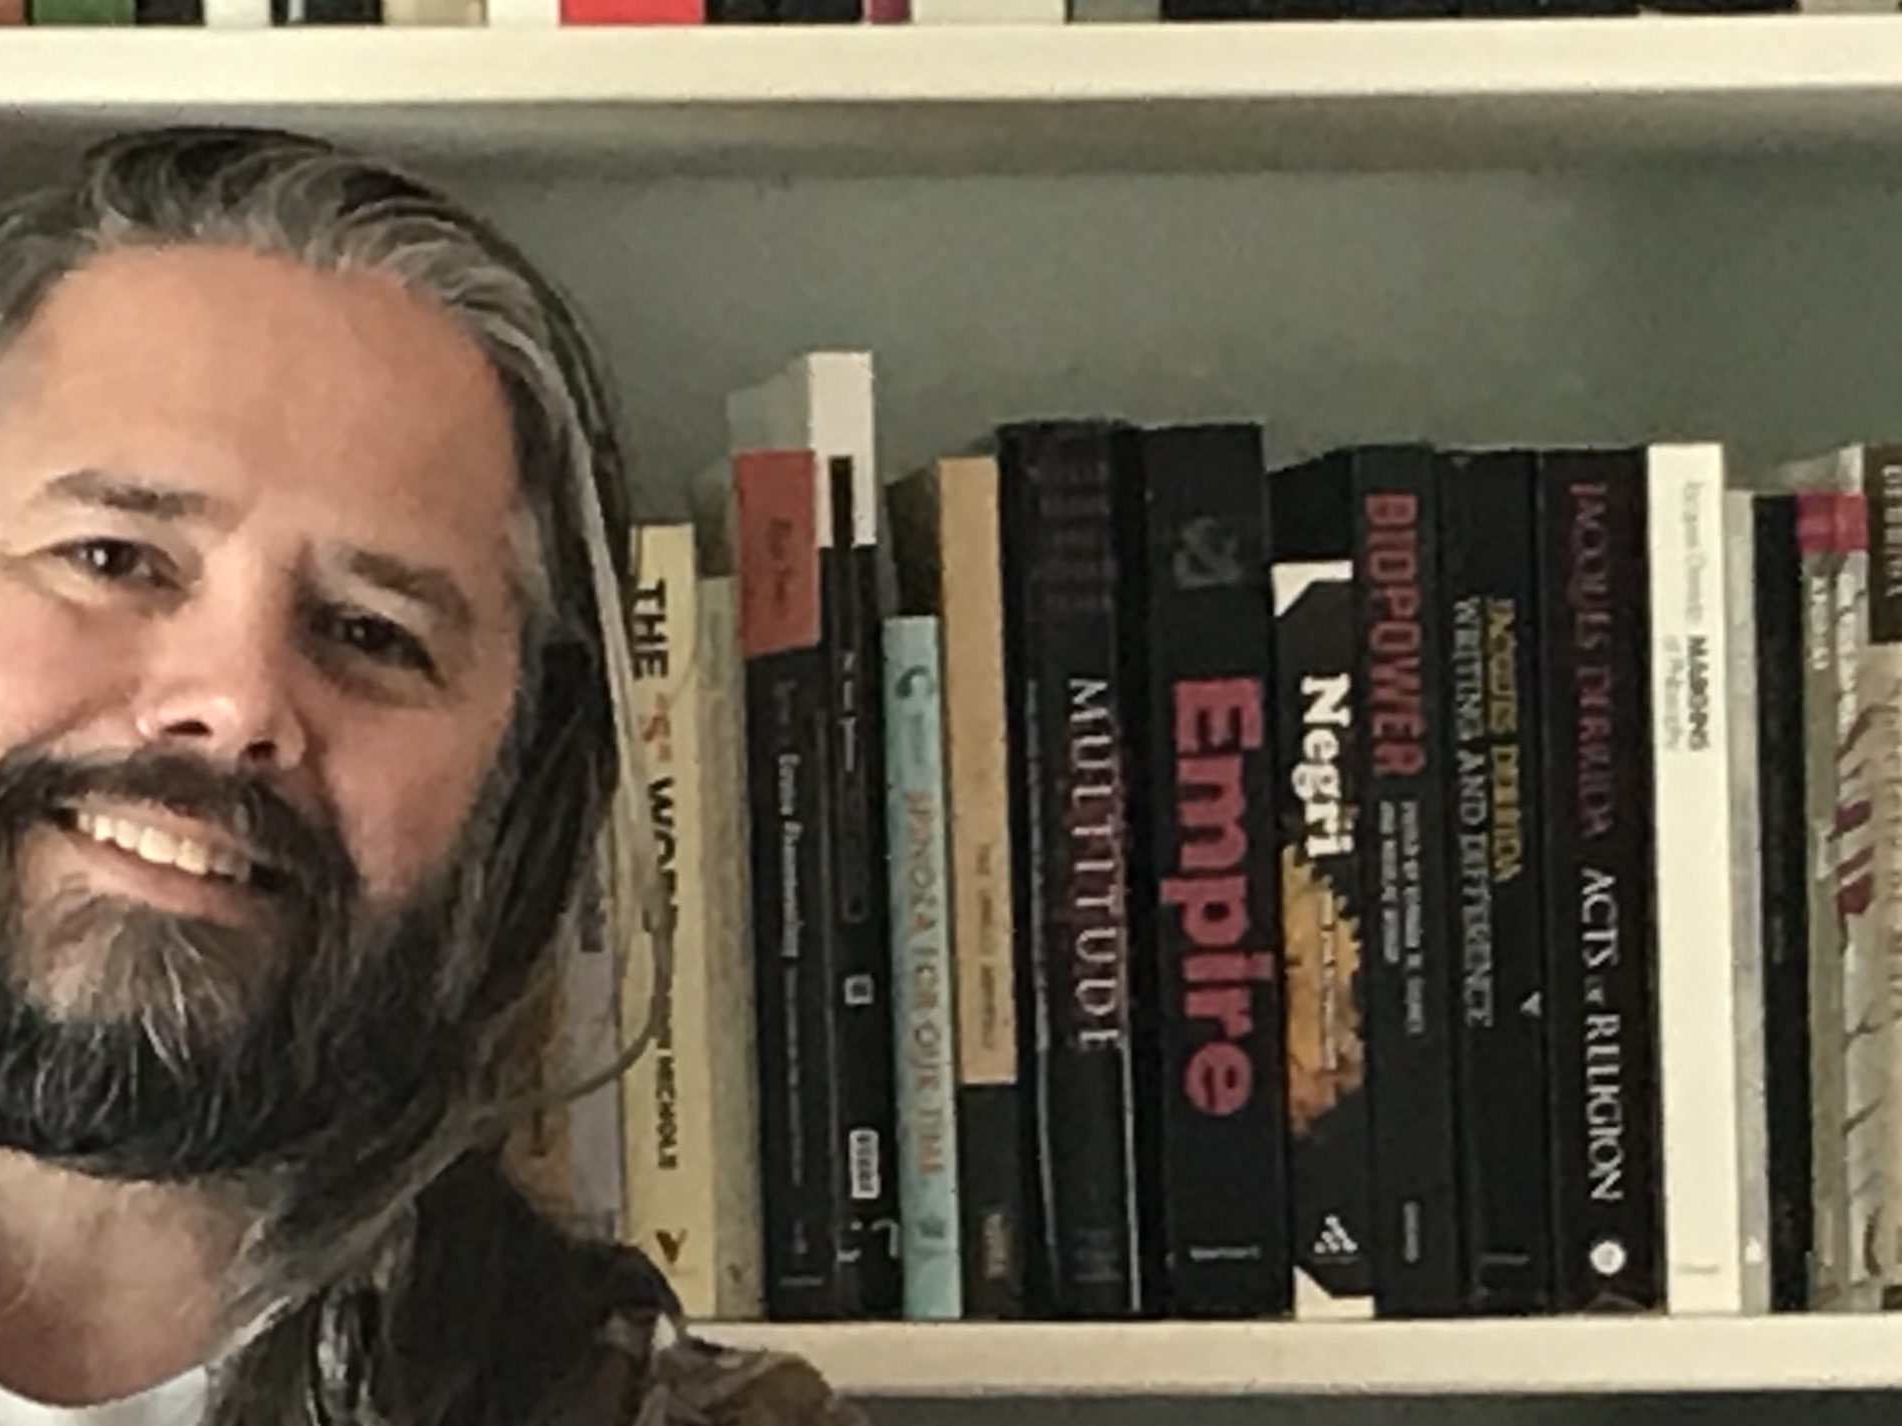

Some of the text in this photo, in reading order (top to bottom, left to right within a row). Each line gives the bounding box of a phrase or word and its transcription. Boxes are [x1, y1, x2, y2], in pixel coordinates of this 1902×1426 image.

[632, 579, 668, 682] THE
[1364, 493, 1426, 776] BIOPOWER
[1291, 671, 1355, 858] Negri
[1452, 596, 1495, 1029] WRITING AND DIFFERENCE
[1159, 677, 1275, 1117] Empire
[1580, 867, 1619, 969] ACTS
[1584, 1012, 1626, 1201] RELIGION
